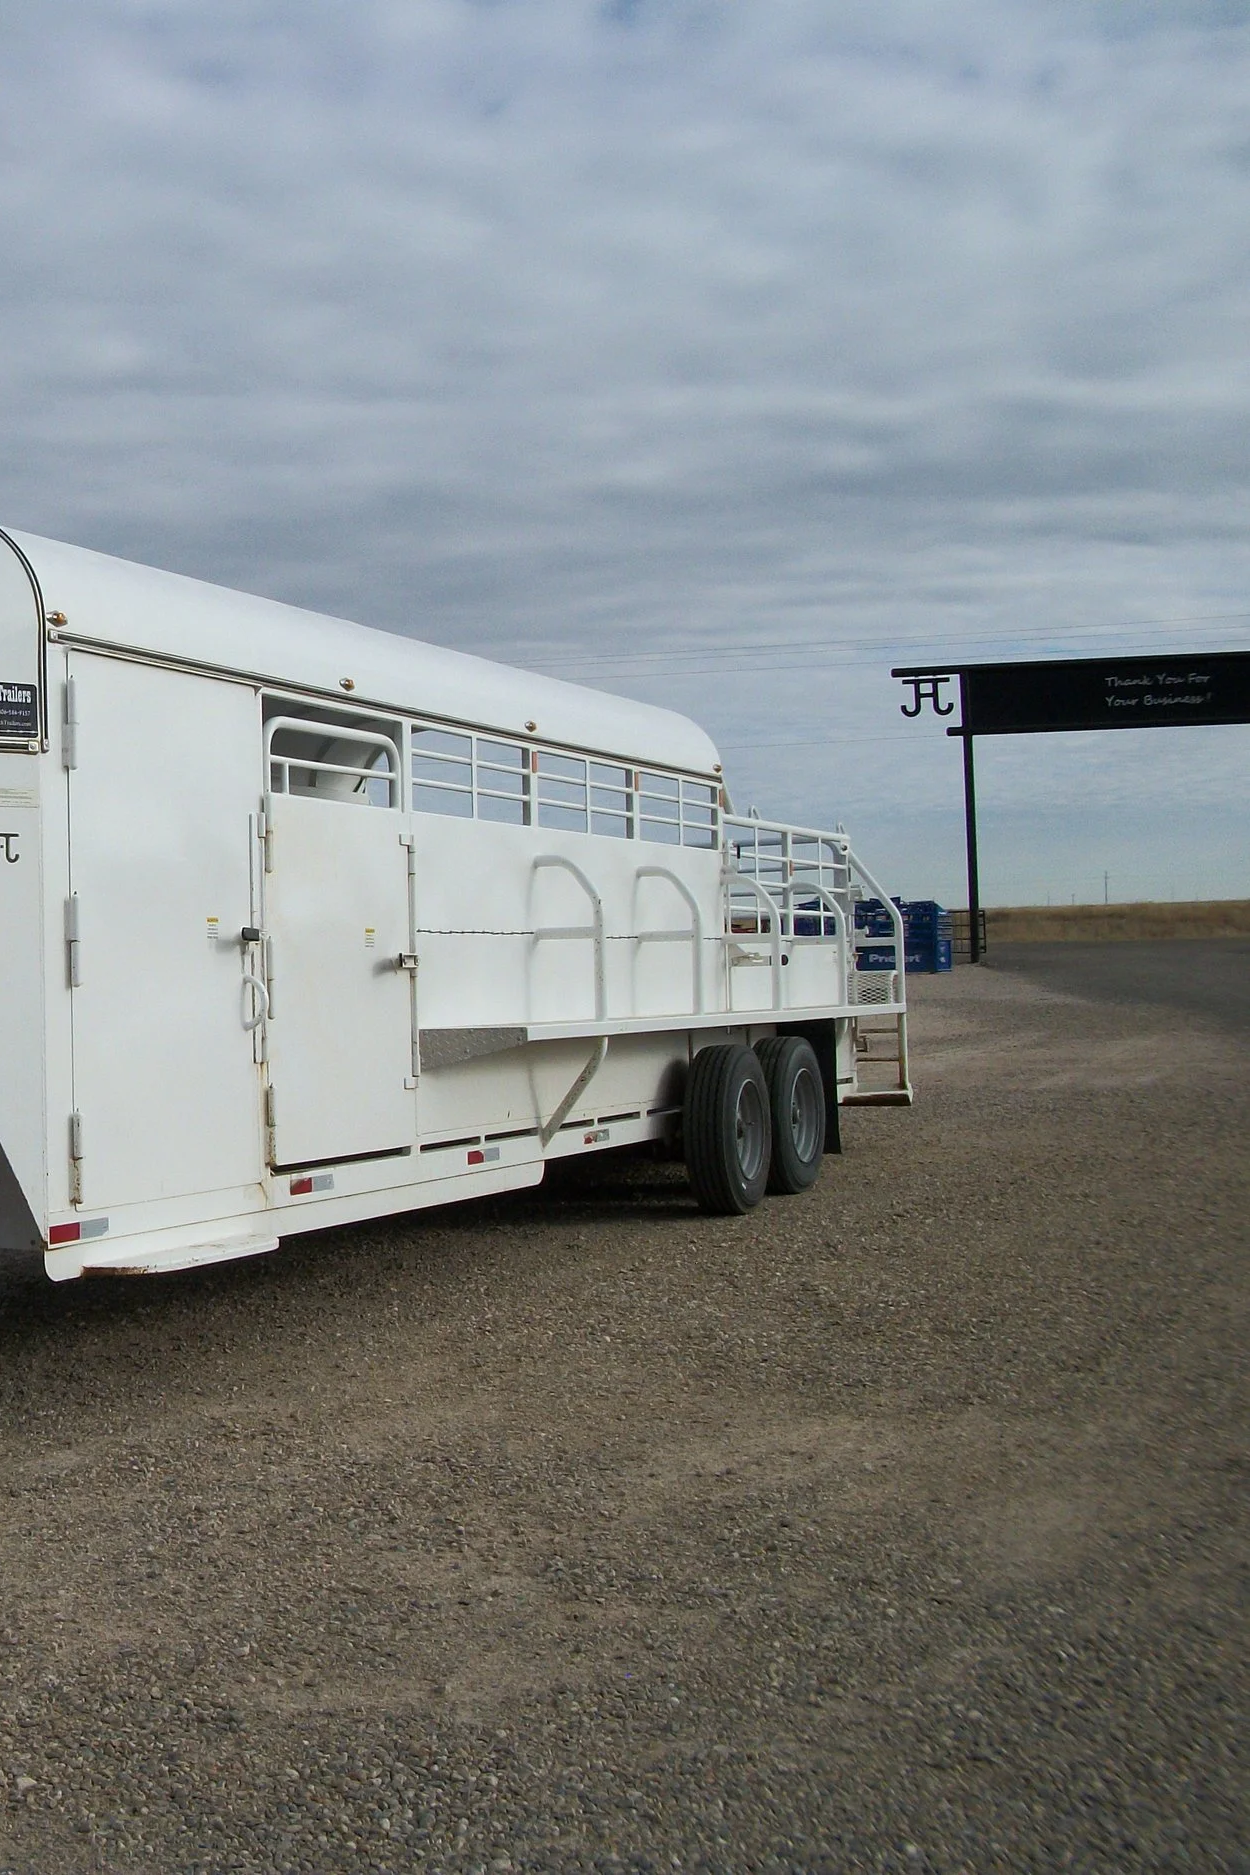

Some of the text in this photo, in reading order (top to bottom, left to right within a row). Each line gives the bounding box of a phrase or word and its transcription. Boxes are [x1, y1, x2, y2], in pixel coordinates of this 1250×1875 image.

[1104, 672, 1211, 687] Thank You For
[1104, 692, 1212, 707] Your Business!
[868, 953, 921, 963] Prieert
